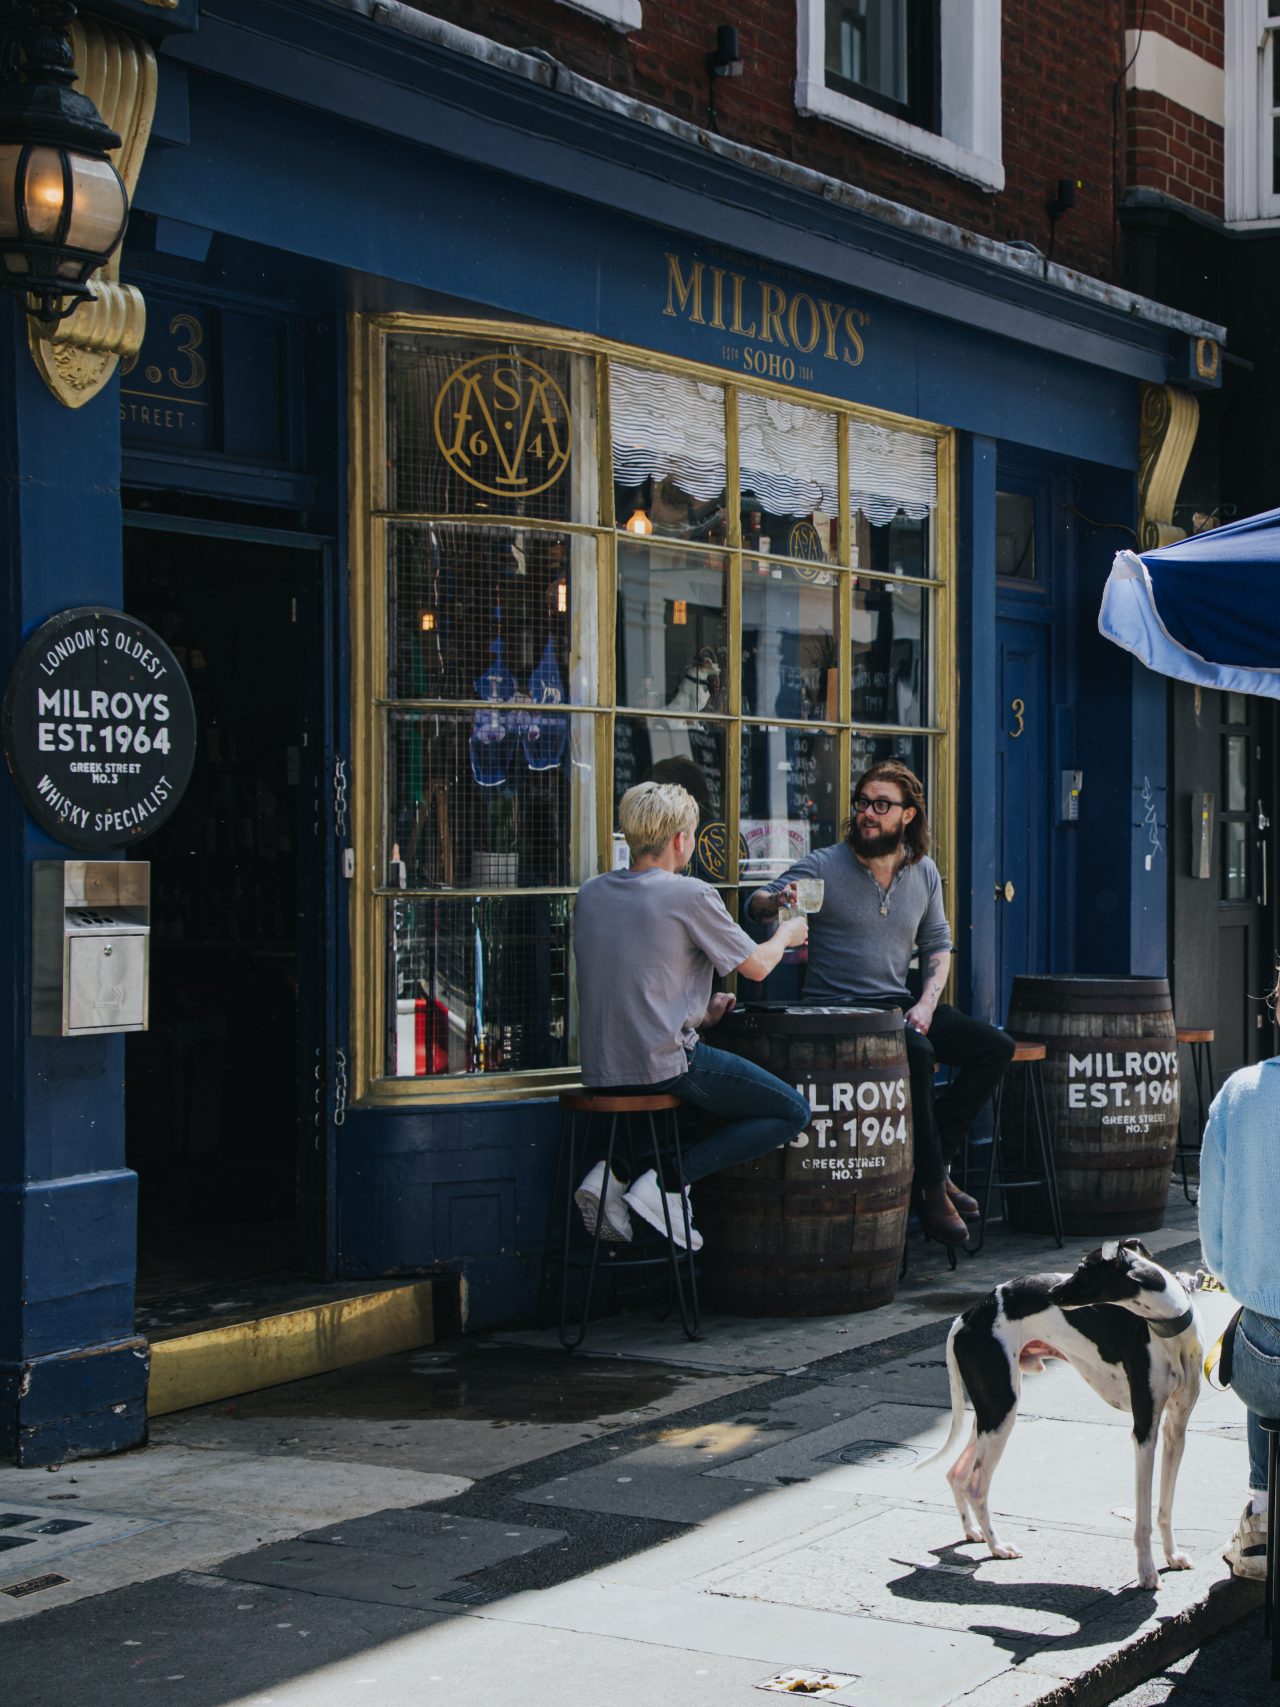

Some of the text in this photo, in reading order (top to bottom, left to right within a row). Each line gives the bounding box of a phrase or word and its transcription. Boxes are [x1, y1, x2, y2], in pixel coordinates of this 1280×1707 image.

[662, 252, 866, 366] MILROYS
[743, 347, 795, 381] SOHO
[120, 403, 185, 429] STREET
[39, 628, 167, 680] LONDON'S OLDEST
[38, 687, 170, 722] MILROYS
[1009, 699, 1025, 738] 3
[69, 762, 141, 774] GREEK STREET
[36, 774, 173, 832] WHISKY SPECIALIST
[1069, 1051, 1178, 1078] MILROYS
[796, 1078, 906, 1112] LROYS
[1102, 1113, 1166, 1125] GREEK STREET
[802, 1156, 886, 1169] GREEK STREET
